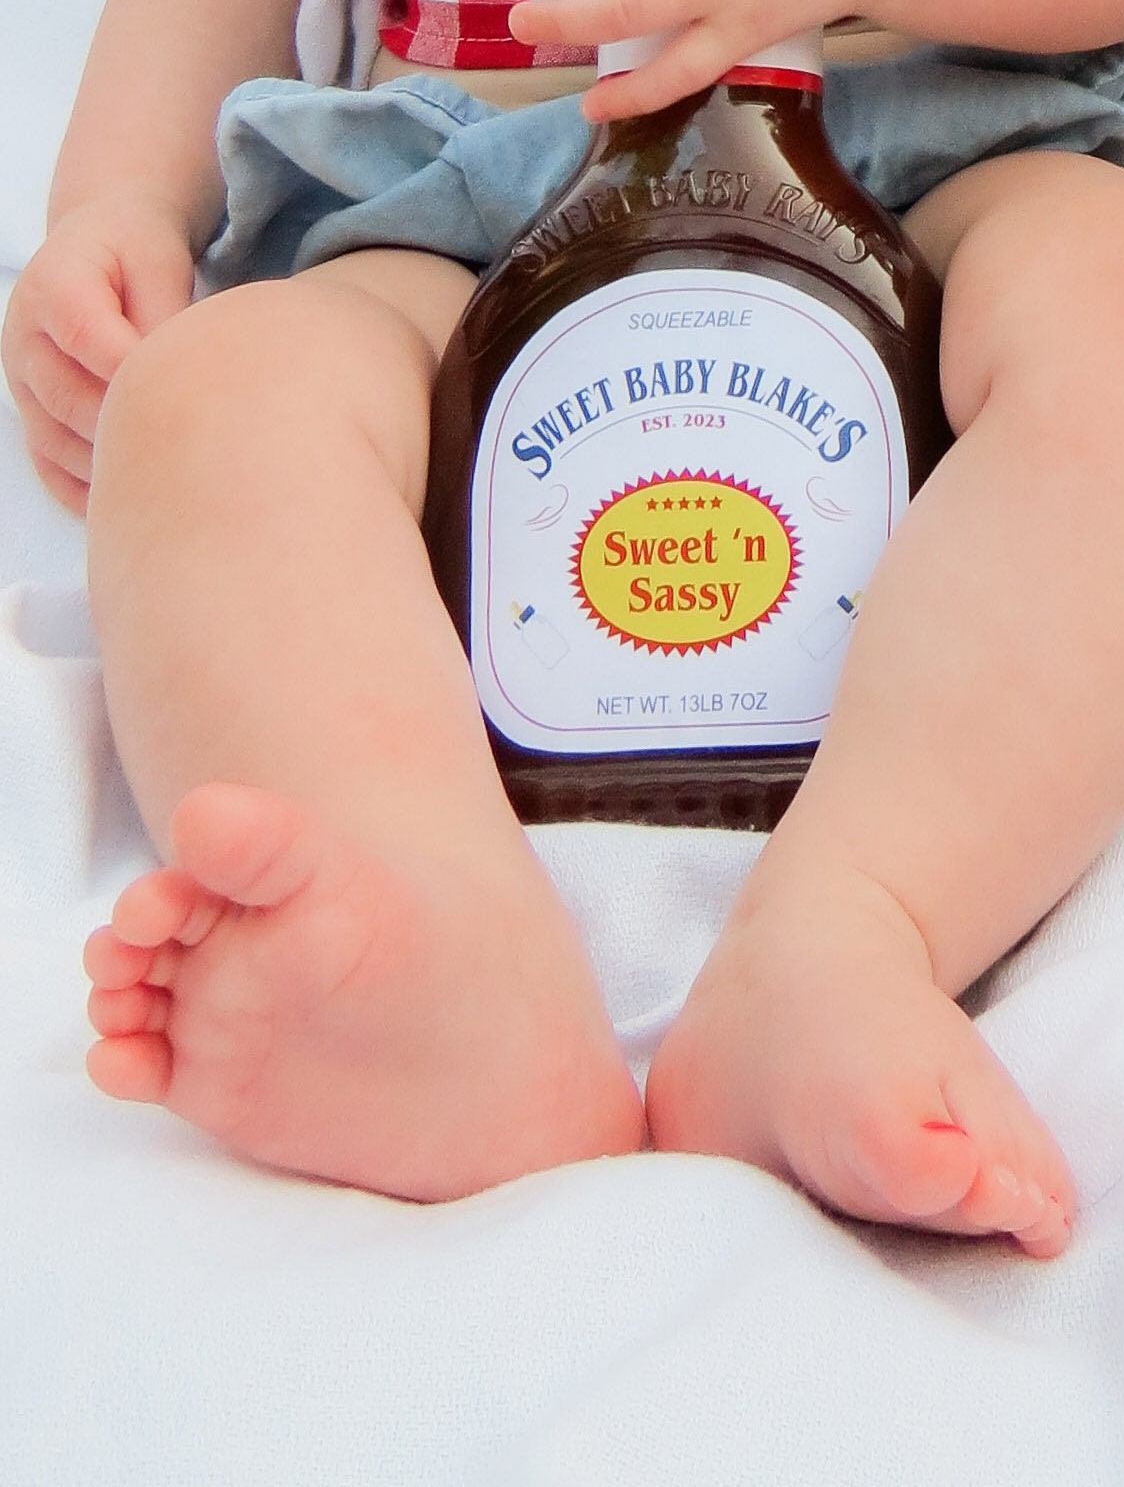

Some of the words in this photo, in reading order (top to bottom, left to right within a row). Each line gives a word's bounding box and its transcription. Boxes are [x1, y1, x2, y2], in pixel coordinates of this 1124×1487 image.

[648, 169, 751, 209] BABY
[628, 309, 753, 330] SQUEEZABLE
[511, 377, 617, 481] SWEET
[623, 358, 717, 404] BABY
[726, 362, 868, 464] BLAKE'S
[641, 414, 677, 434] EST.
[683, 413, 726, 429] 2023
[603, 527, 718, 568] Sweet
[628, 577, 742, 621] Sassy
[596, 696, 635, 715] NET
[640, 695, 672, 714] WT.
[680, 693, 723, 713] 13LB
[730, 692, 768, 711] 7OZ
